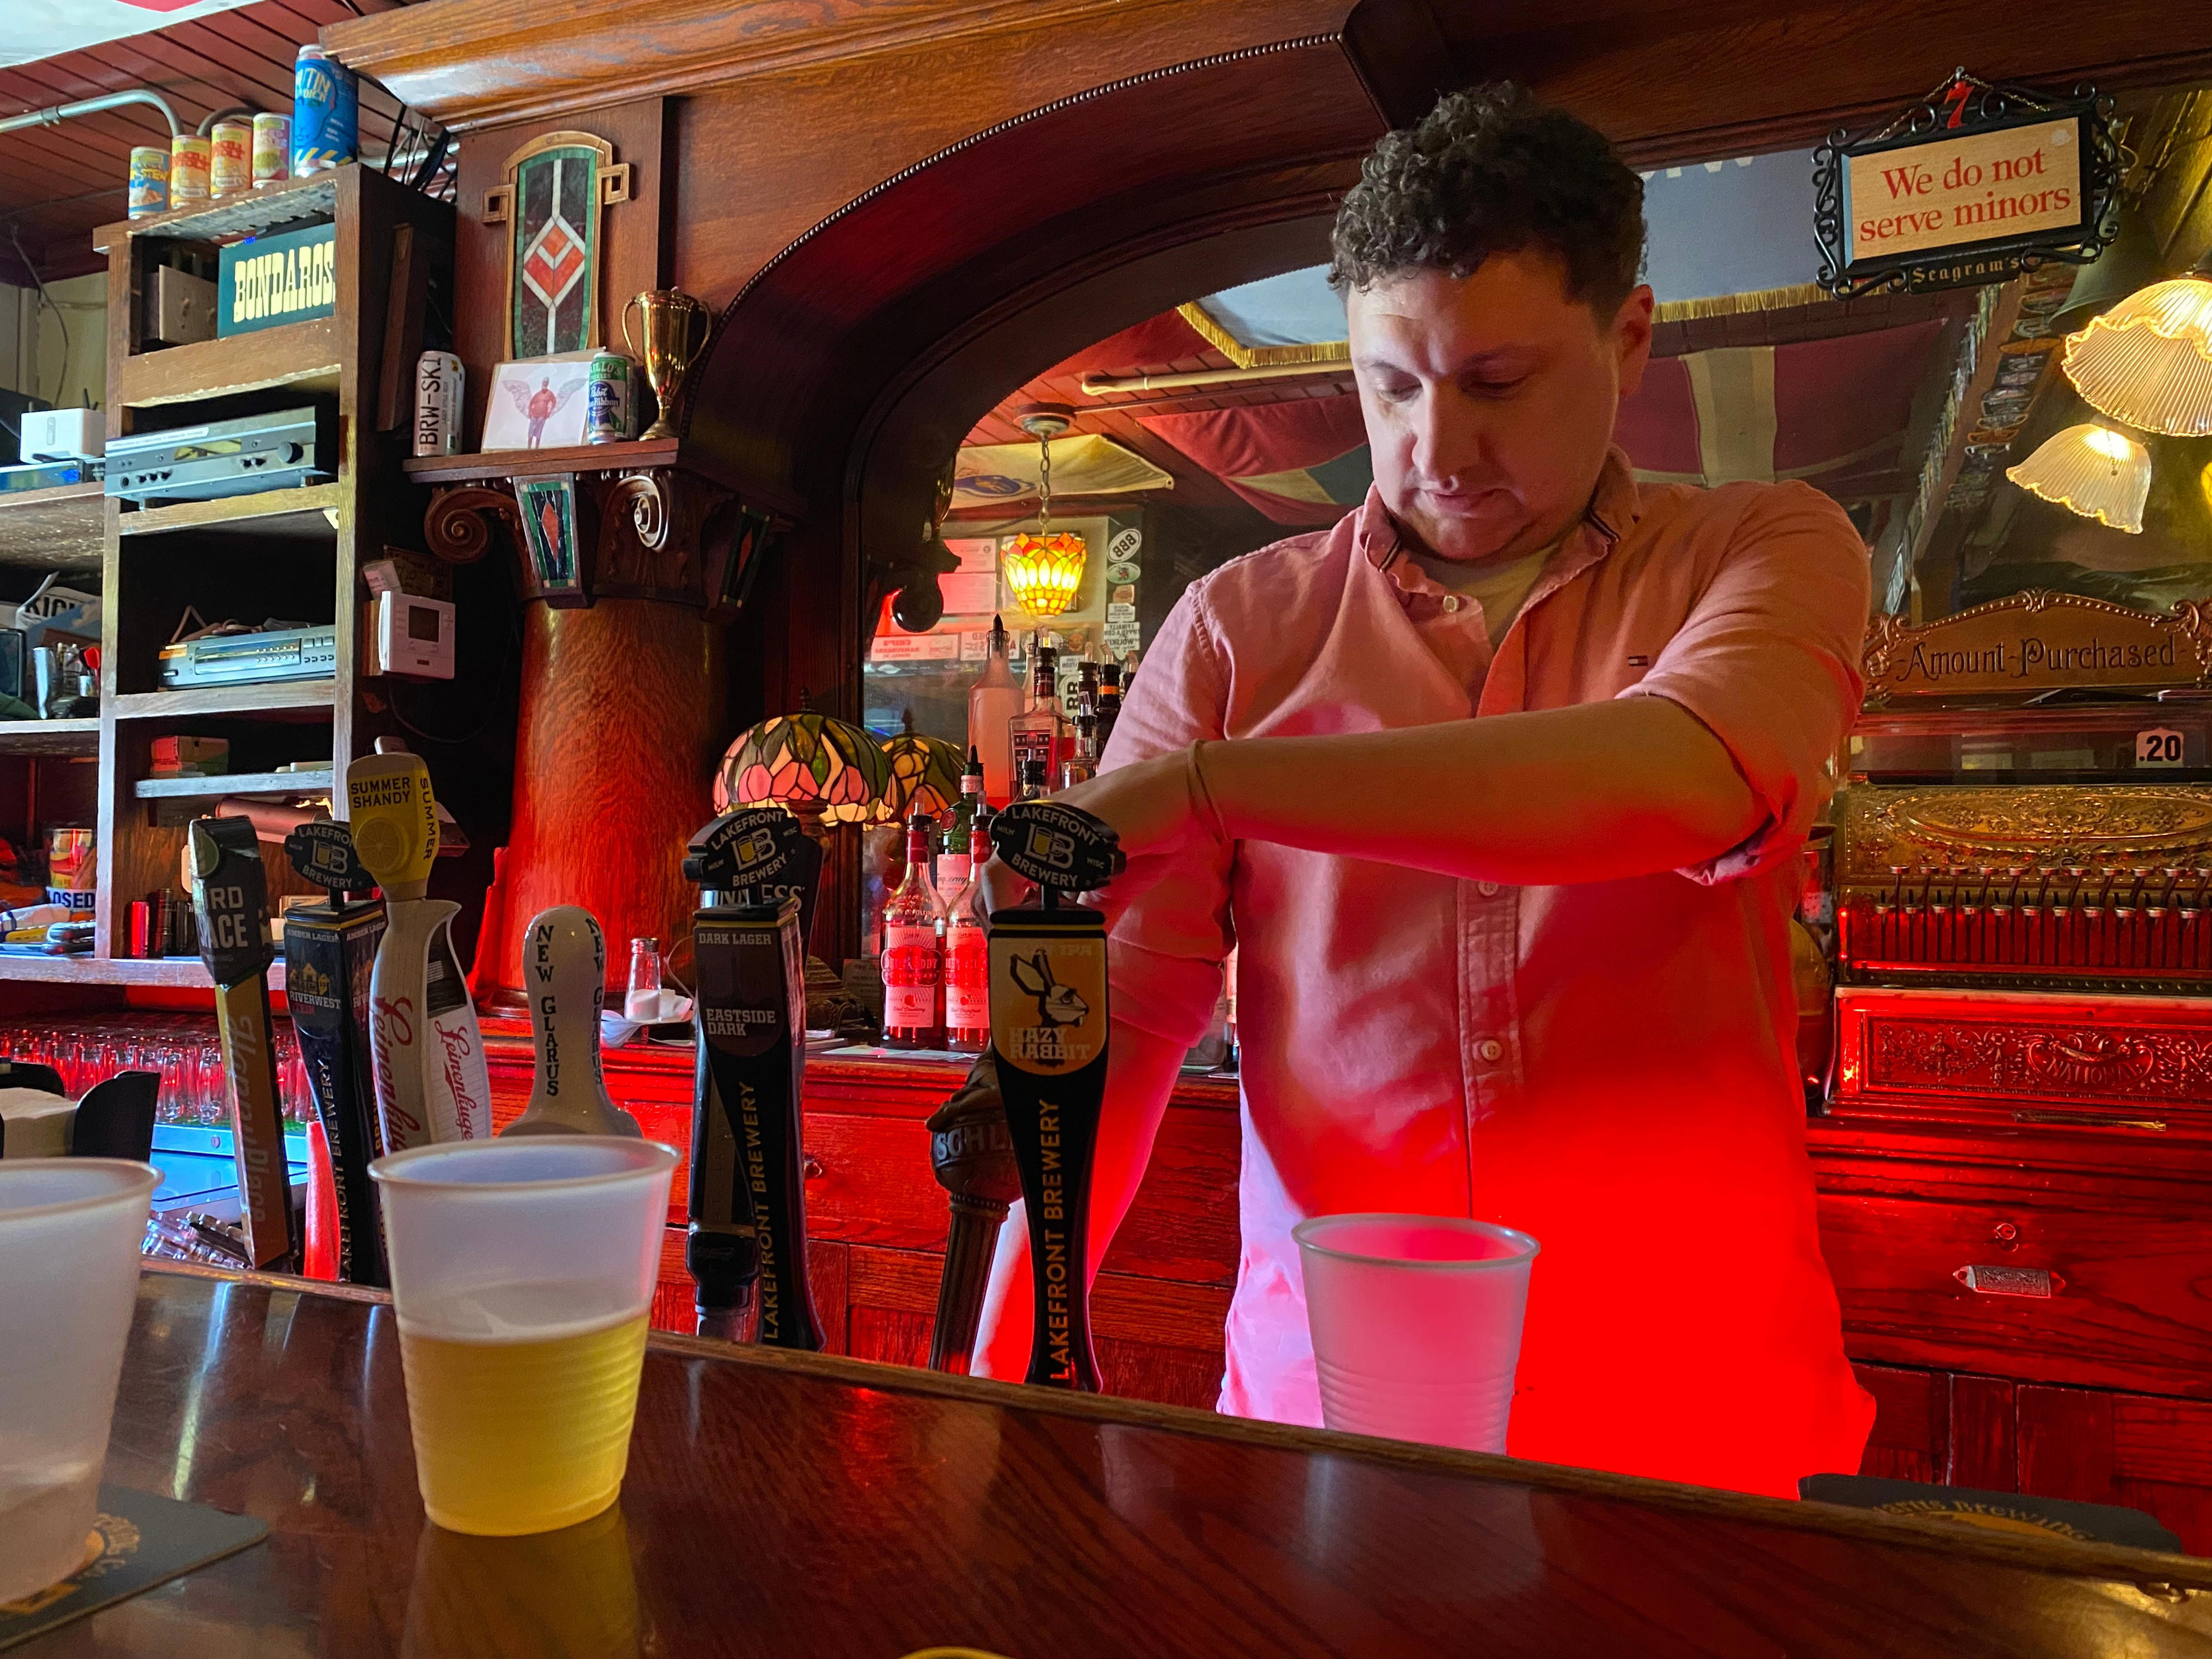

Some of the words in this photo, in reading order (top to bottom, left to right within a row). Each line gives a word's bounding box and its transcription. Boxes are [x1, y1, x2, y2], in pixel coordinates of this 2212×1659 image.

[1944, 81, 1974, 128] 7
[1881, 164, 1933, 199] We
[1943, 156, 1983, 189] do
[1992, 147, 2047, 182] not
[1860, 209, 1943, 241] serve
[1953, 187, 2071, 226] minors
[234, 240, 335, 323] BONDAROS
[1912, 257, 2019, 283] Seagram's
[420, 357, 441, 445] BRW-SKI
[591, 385, 608, 398] Pabst
[594, 397, 619, 406] Ribbon
[2139, 735, 2181, 761] .20
[351, 777, 410, 795] SUMMER
[353, 791, 410, 808] SHANDY
[420, 778, 435, 860] SUMMER
[711, 811, 784, 851] LAKEFRONT
[1011, 807, 1100, 846] LAKEFRONT
[299, 827, 353, 847] LAKEFRO
[302, 865, 353, 889] BREWERY
[732, 852, 787, 886] BREWERY
[1011, 853, 1078, 888] BREWERY
[52, 890, 95, 909] OSED
[204, 886, 244, 910] IRD
[286, 928, 311, 938] AMBER
[313, 930, 339, 942] LAGER
[346, 927, 368, 941] AMBER
[369, 922, 386, 934] LAGER
[698, 933, 729, 944] DARK
[732, 934, 772, 945] LAGER
[536, 924, 554, 982] NEW
[290, 990, 341, 1010] RIVERWEST
[705, 1008, 776, 1024] EASTSIDE
[707, 1022, 747, 1036] DARK
[541, 996, 560, 1097] GLARUS
[1009, 1027, 1067, 1043] HAZY
[1010, 1043, 1091, 1060] RABBIT
[317, 1059, 343, 1158] BREWERY
[739, 1081, 767, 1194] BREWERY
[1039, 1098, 1063, 1219] BREWERY
[754, 1199, 779, 1339] LAKEFRONT
[1044, 1229, 1069, 1380] LAKEFRONT
